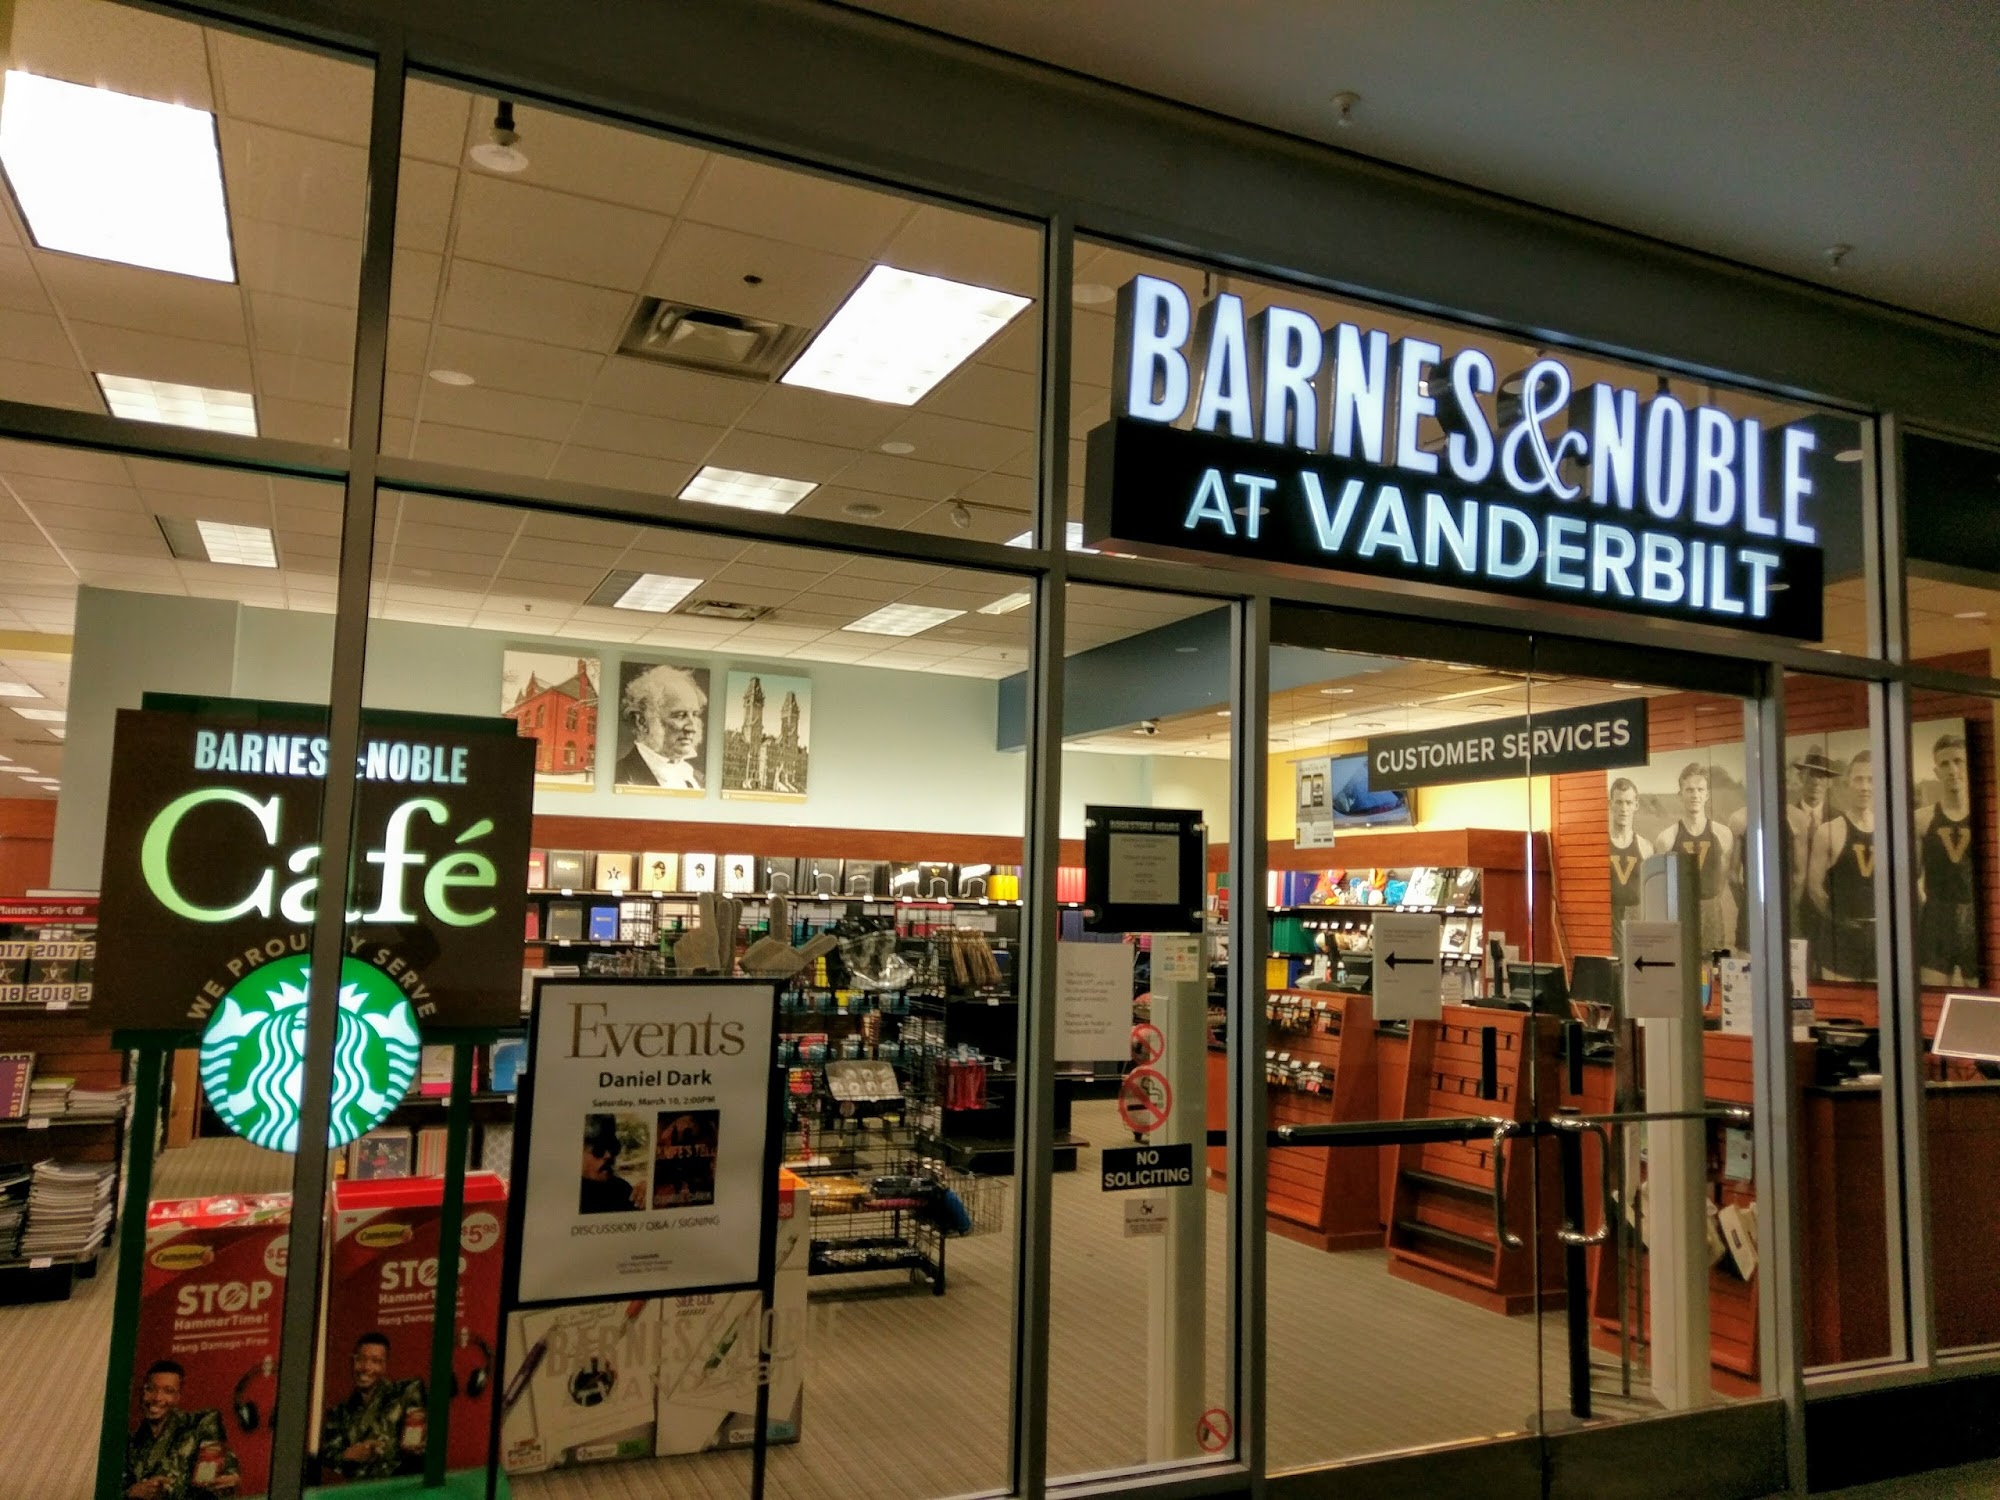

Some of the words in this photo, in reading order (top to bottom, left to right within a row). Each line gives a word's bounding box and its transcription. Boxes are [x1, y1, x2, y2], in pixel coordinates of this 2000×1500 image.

[1183, 468, 1277, 539] AT
[1301, 471, 1780, 618] VANDERBILT
[194, 730, 328, 778] BARNES
[366, 740, 469, 784] NOBLE
[1375, 736, 1495, 774] CUSTOMER
[1502, 718, 1631, 760] SERVICES
[141, 788, 498, 928] Café
[34, 944, 77, 957] 2017
[186, 979, 226, 1020] WE
[227, 933, 366, 977] PROUY
[373, 948, 438, 1018] SERVE
[29, 987, 72, 1001] 2018
[564, 1002, 746, 1059] Events
[599, 1071, 662, 1088] Daniel
[667, 1069, 712, 1086] Dark
[638, 1097, 667, 1106] March
[1136, 1150, 1159, 1165] NO
[1104, 1167, 1190, 1187] SOLICITING
[570, 1222, 637, 1237] DISCUSSION
[678, 1215, 721, 1229] SIGNING
[176, 1280, 273, 1315] STOP
